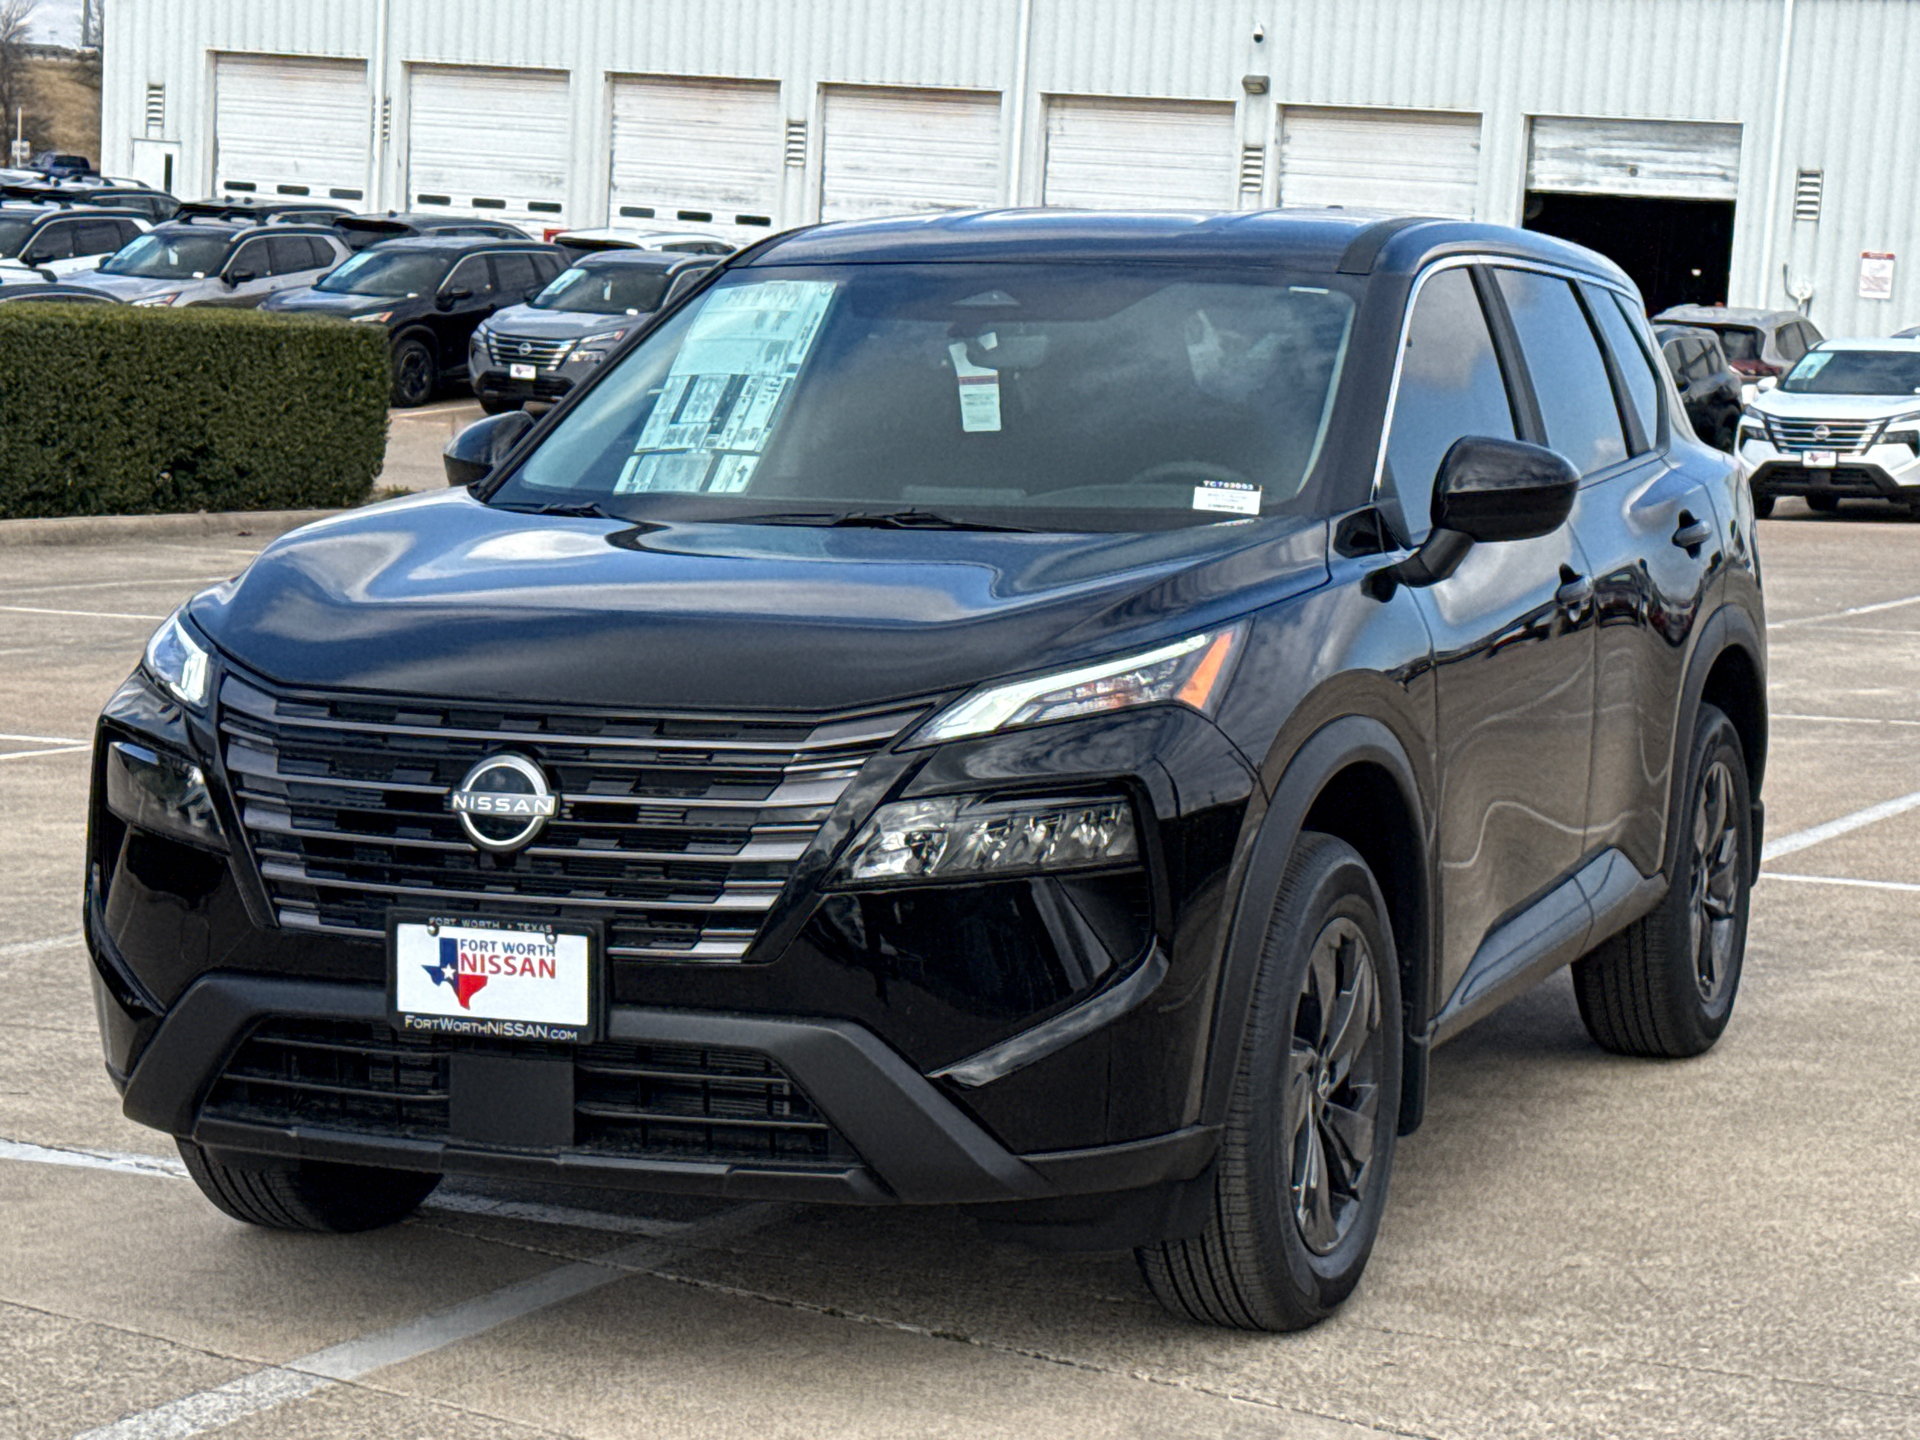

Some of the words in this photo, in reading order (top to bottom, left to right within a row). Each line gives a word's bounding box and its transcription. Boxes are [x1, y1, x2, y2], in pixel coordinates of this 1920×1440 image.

[452, 794, 552, 813] NISSAN
[429, 916, 456, 926] FORT
[461, 919, 500, 929] WORTH
[517, 922, 552, 933] TEXAS
[460, 938, 498, 953] FORT
[502, 941, 556, 957] WORTH
[460, 952, 556, 979] NISSAN
